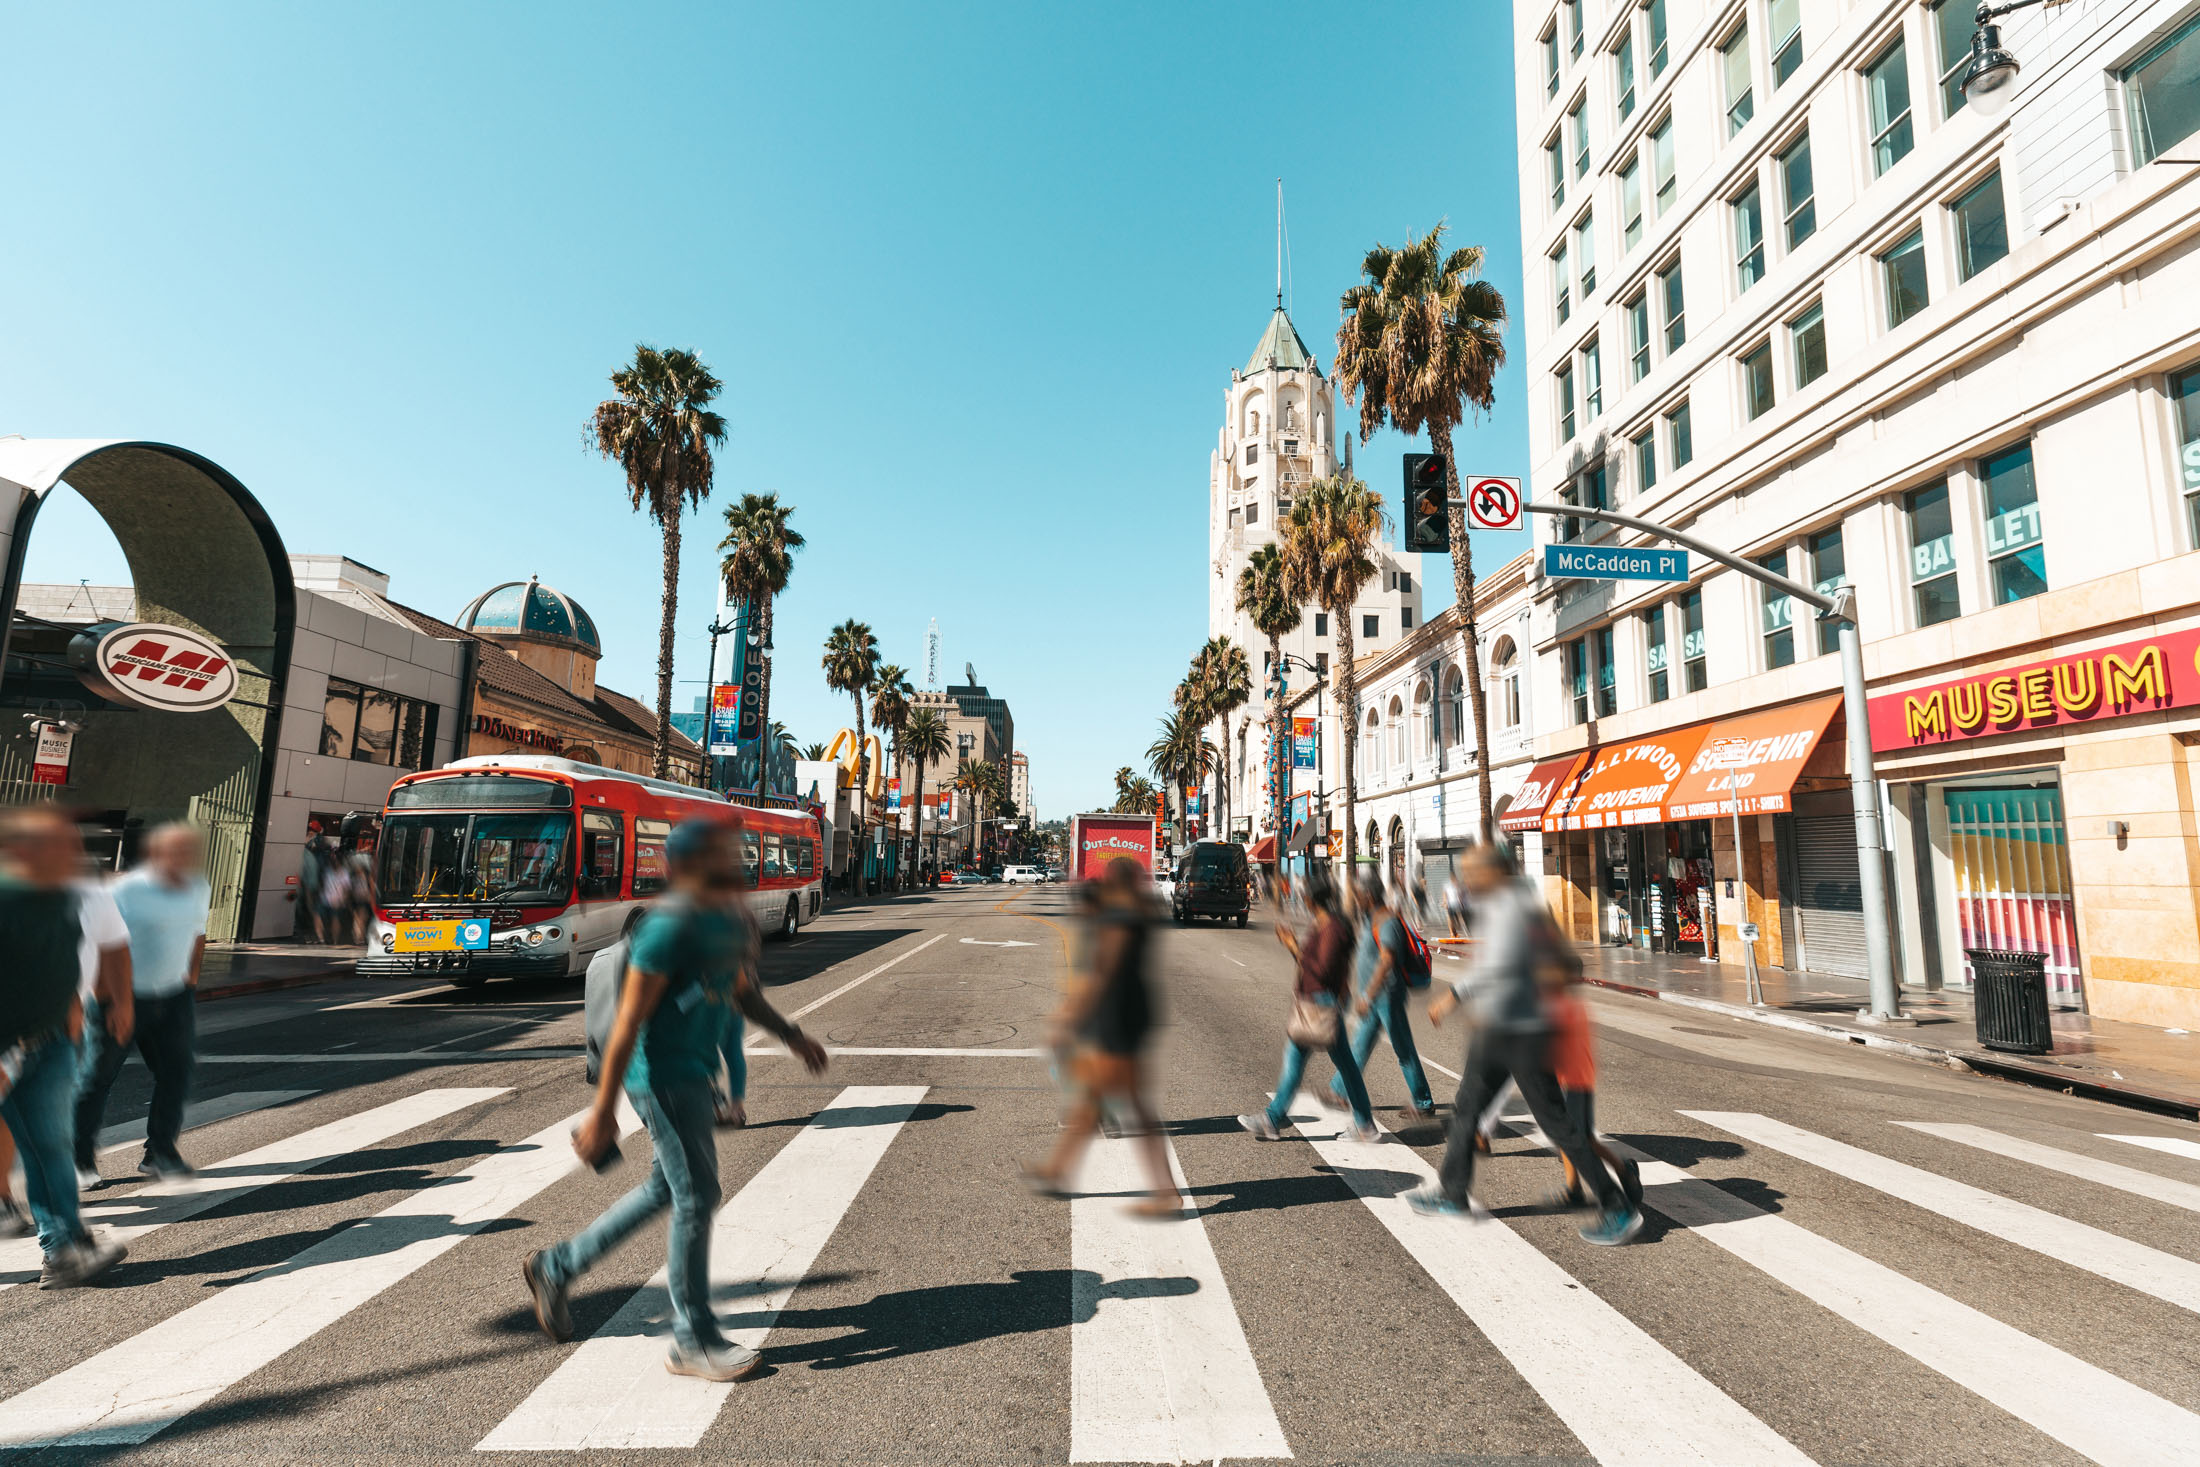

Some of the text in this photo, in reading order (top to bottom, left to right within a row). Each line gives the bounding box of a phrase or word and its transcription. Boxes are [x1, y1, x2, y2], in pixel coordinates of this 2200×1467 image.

[1986, 502, 2040, 553] LET
[1558, 552, 1675, 574] McCadden Pl
[112, 653, 217, 682] MUSICIANS INSTITUTE
[928, 639, 936, 683] CAPITAN
[1904, 645, 2168, 742] MUSEUM
[40, 746, 66, 754] BUSINESS
[42, 739, 68, 748] MUSIC
[1690, 730, 1814, 774] SOVENIR
[1561, 744, 1681, 798] HOLLYWOOD
[1706, 773, 1755, 792] LAND
[1548, 784, 1669, 815] BEST SOUVENIR
[1082, 840, 1103, 851] OUT
[1109, 836, 1145, 852] CLOSET
[404, 930, 442, 941] WOW!
